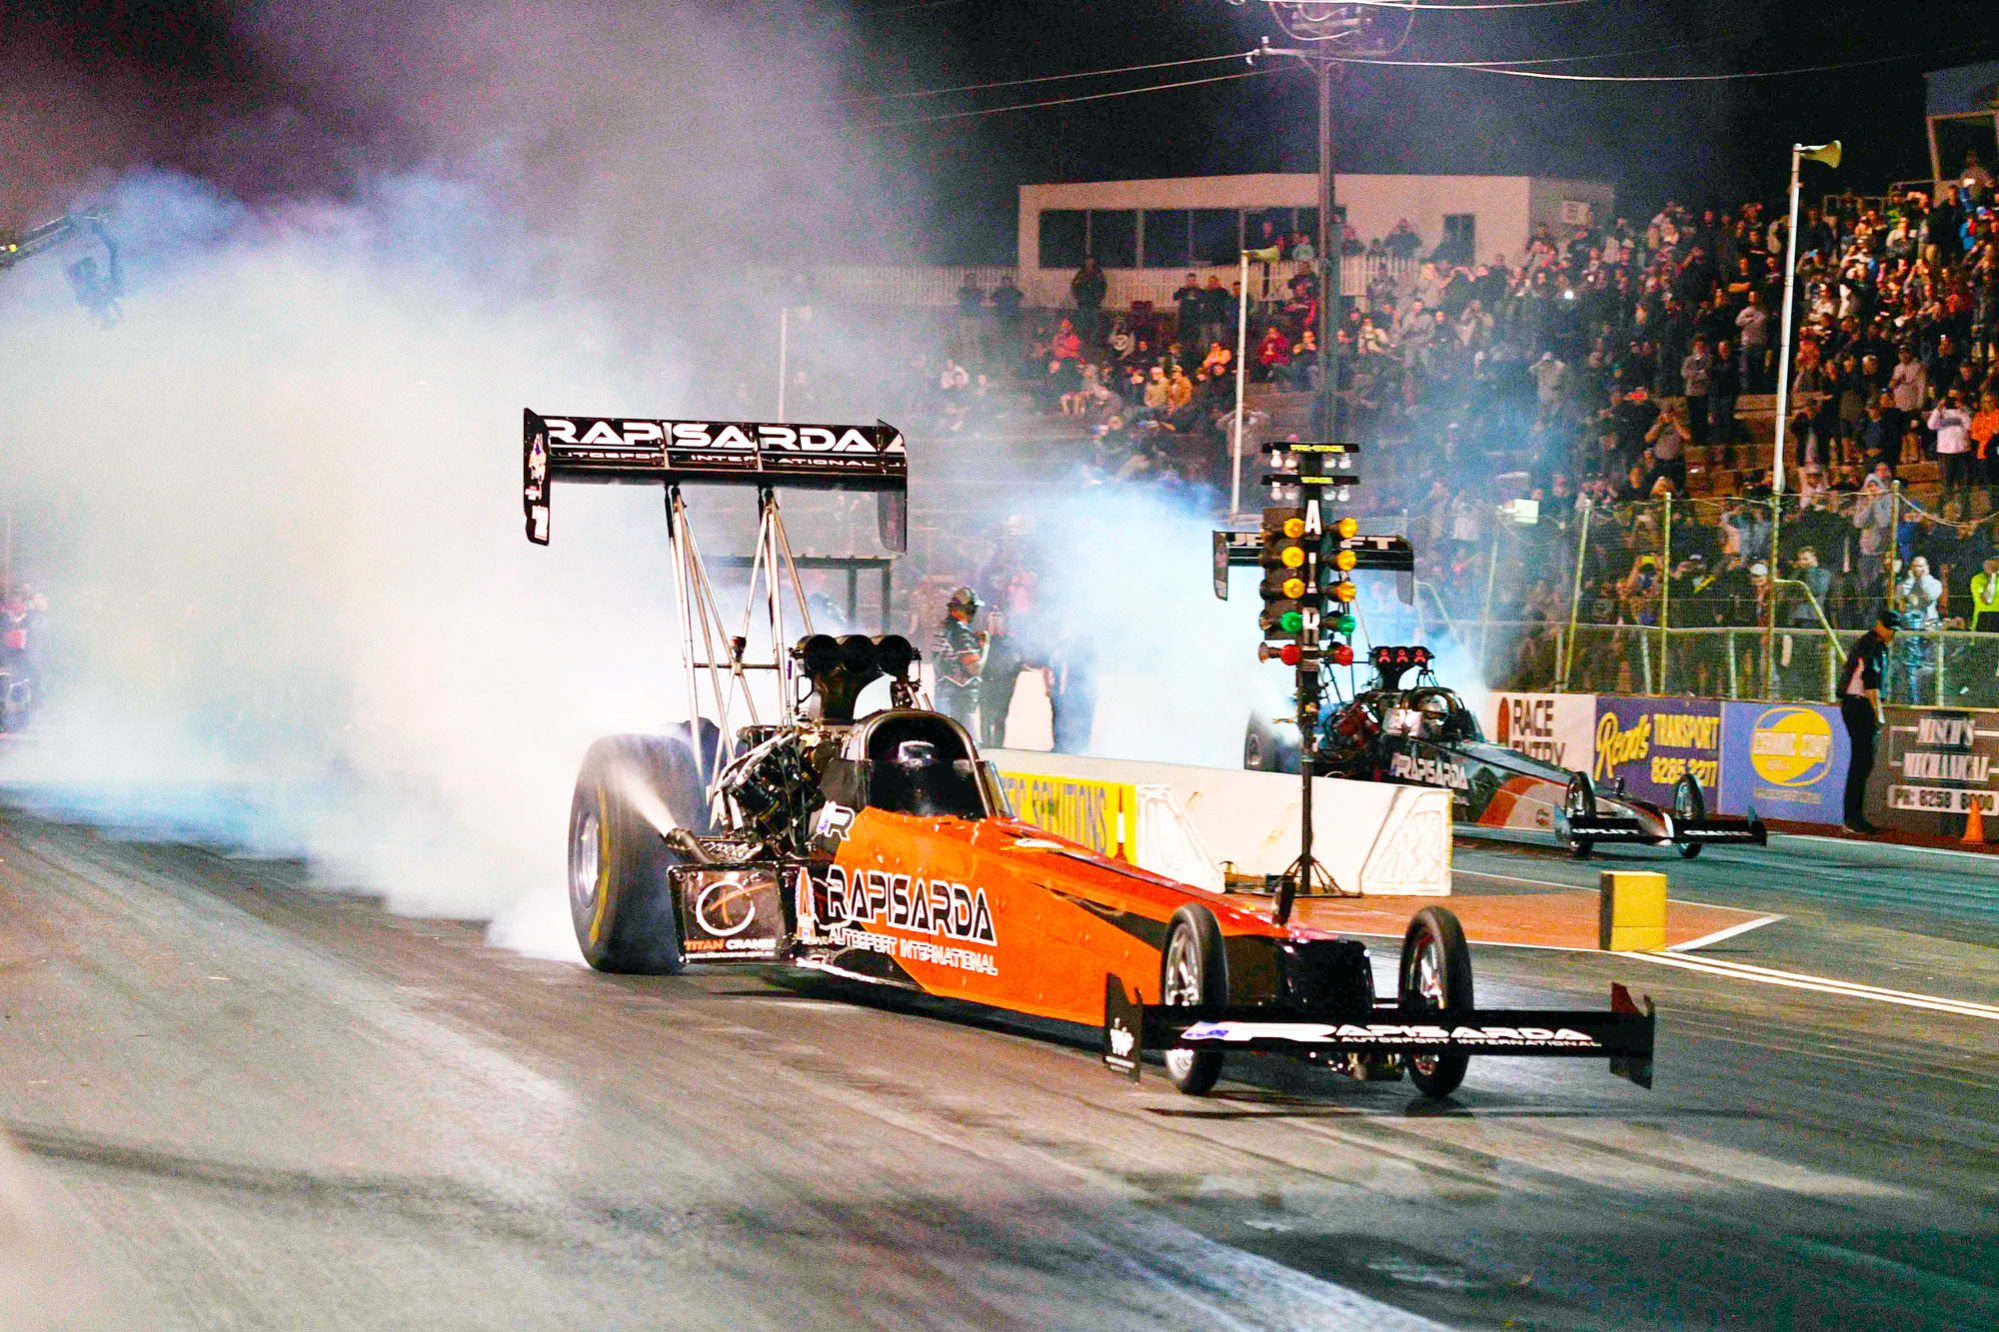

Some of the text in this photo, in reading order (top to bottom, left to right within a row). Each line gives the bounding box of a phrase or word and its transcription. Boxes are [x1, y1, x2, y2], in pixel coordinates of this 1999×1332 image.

[543, 419, 877, 452] RAPISARDA
[1513, 698, 1555, 736] RACE
[827, 864, 998, 947] RAPISARDA
[684, 938, 725, 951] TITAN
